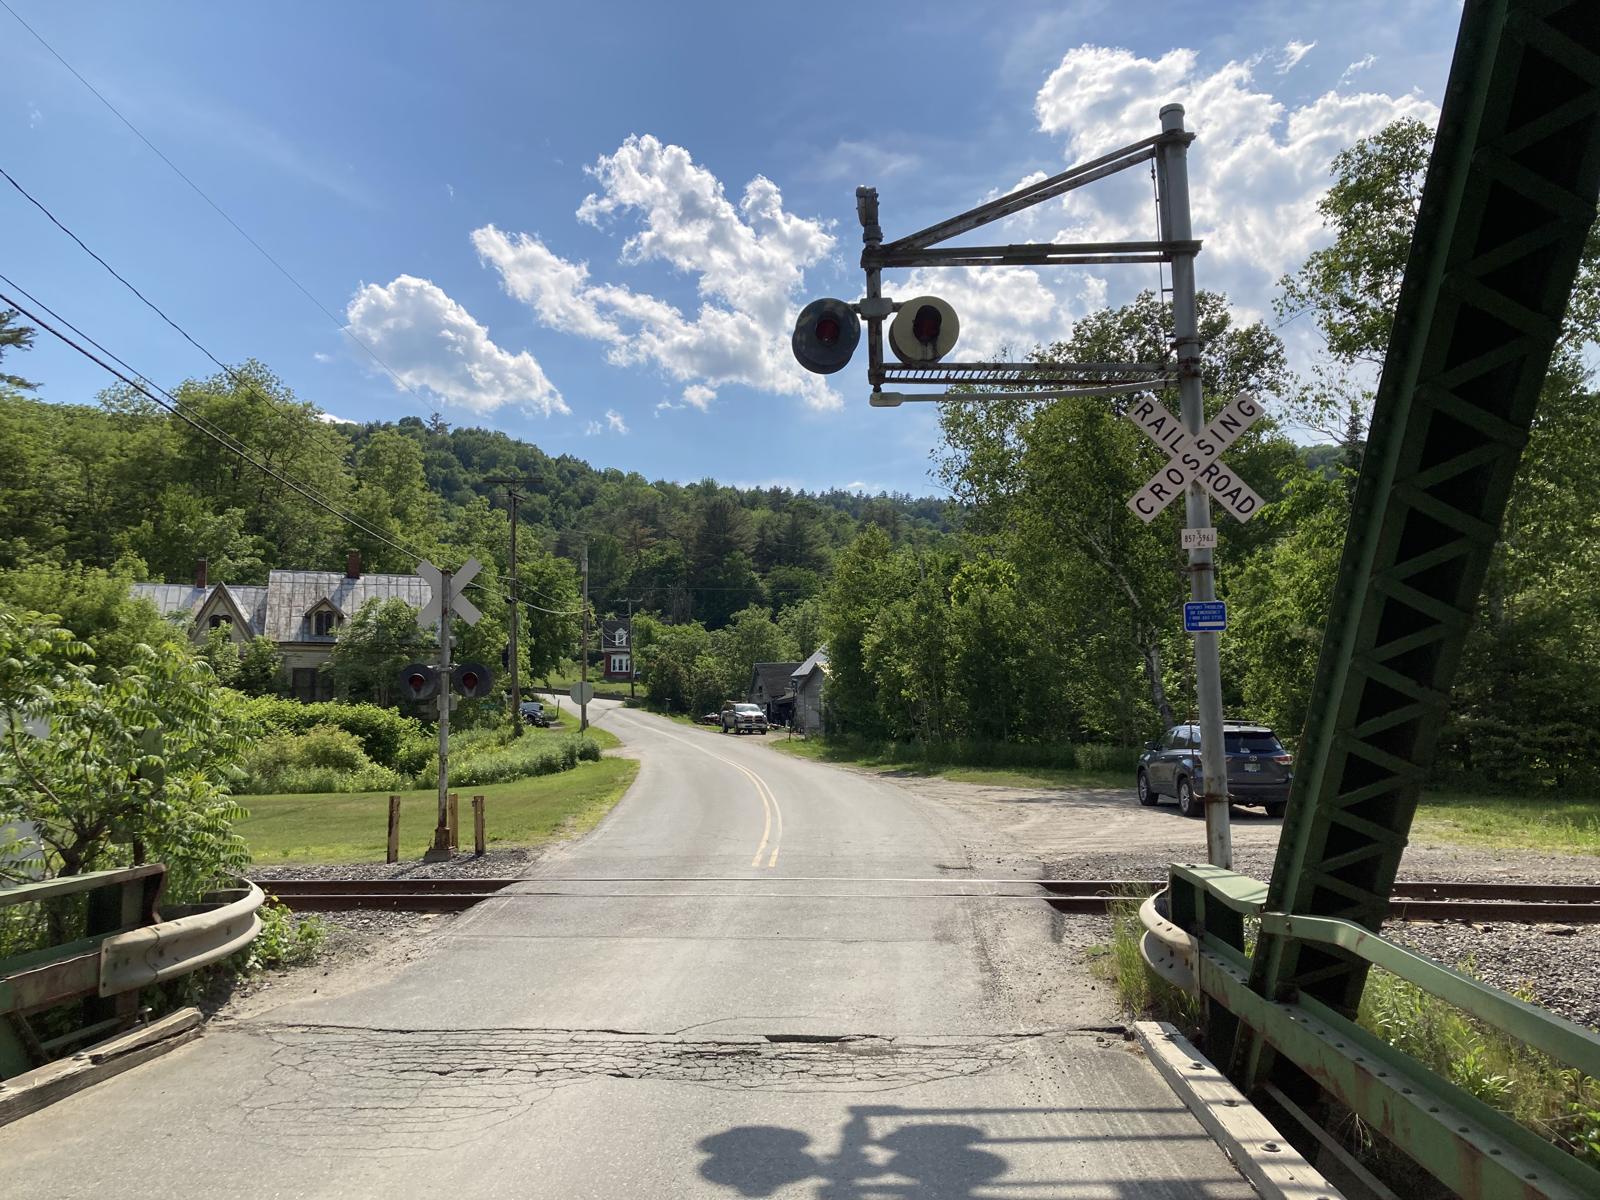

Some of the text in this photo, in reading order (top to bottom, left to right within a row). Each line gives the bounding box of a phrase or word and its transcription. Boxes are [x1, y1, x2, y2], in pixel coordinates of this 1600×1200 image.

[1135, 401, 1255, 514] RAIL ROAD
[1136, 400, 1255, 515] CROSSING
